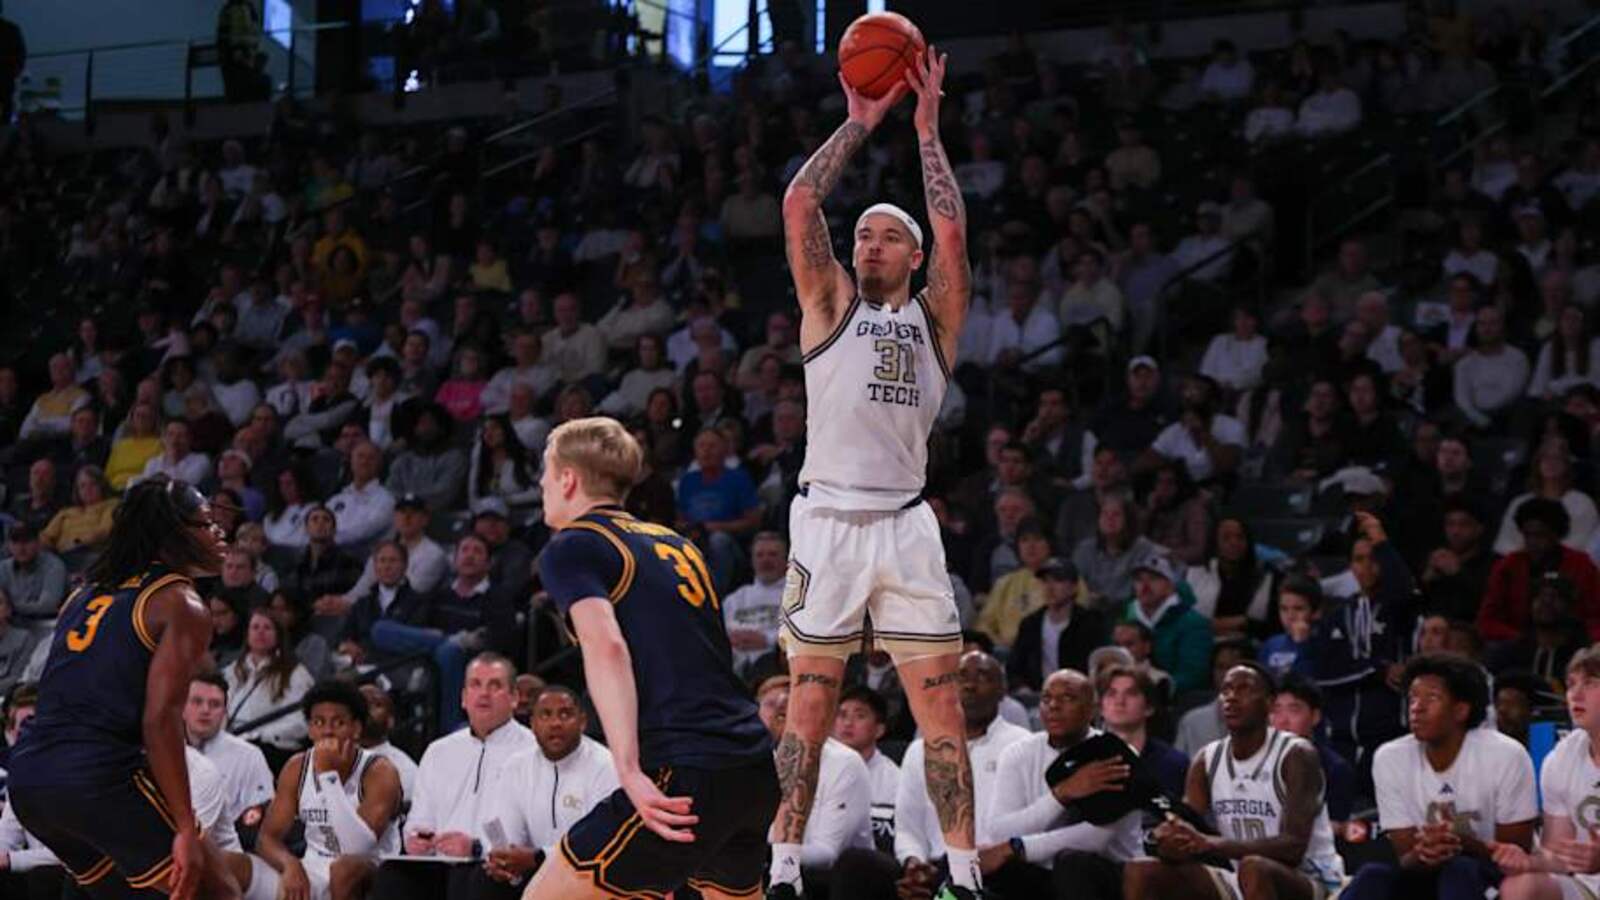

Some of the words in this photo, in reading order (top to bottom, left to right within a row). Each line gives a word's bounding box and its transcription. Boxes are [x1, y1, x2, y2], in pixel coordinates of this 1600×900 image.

[874, 339, 916, 384] 31
[868, 384, 920, 407] TECH
[653, 541, 719, 612] 31
[66, 594, 113, 652] 3
